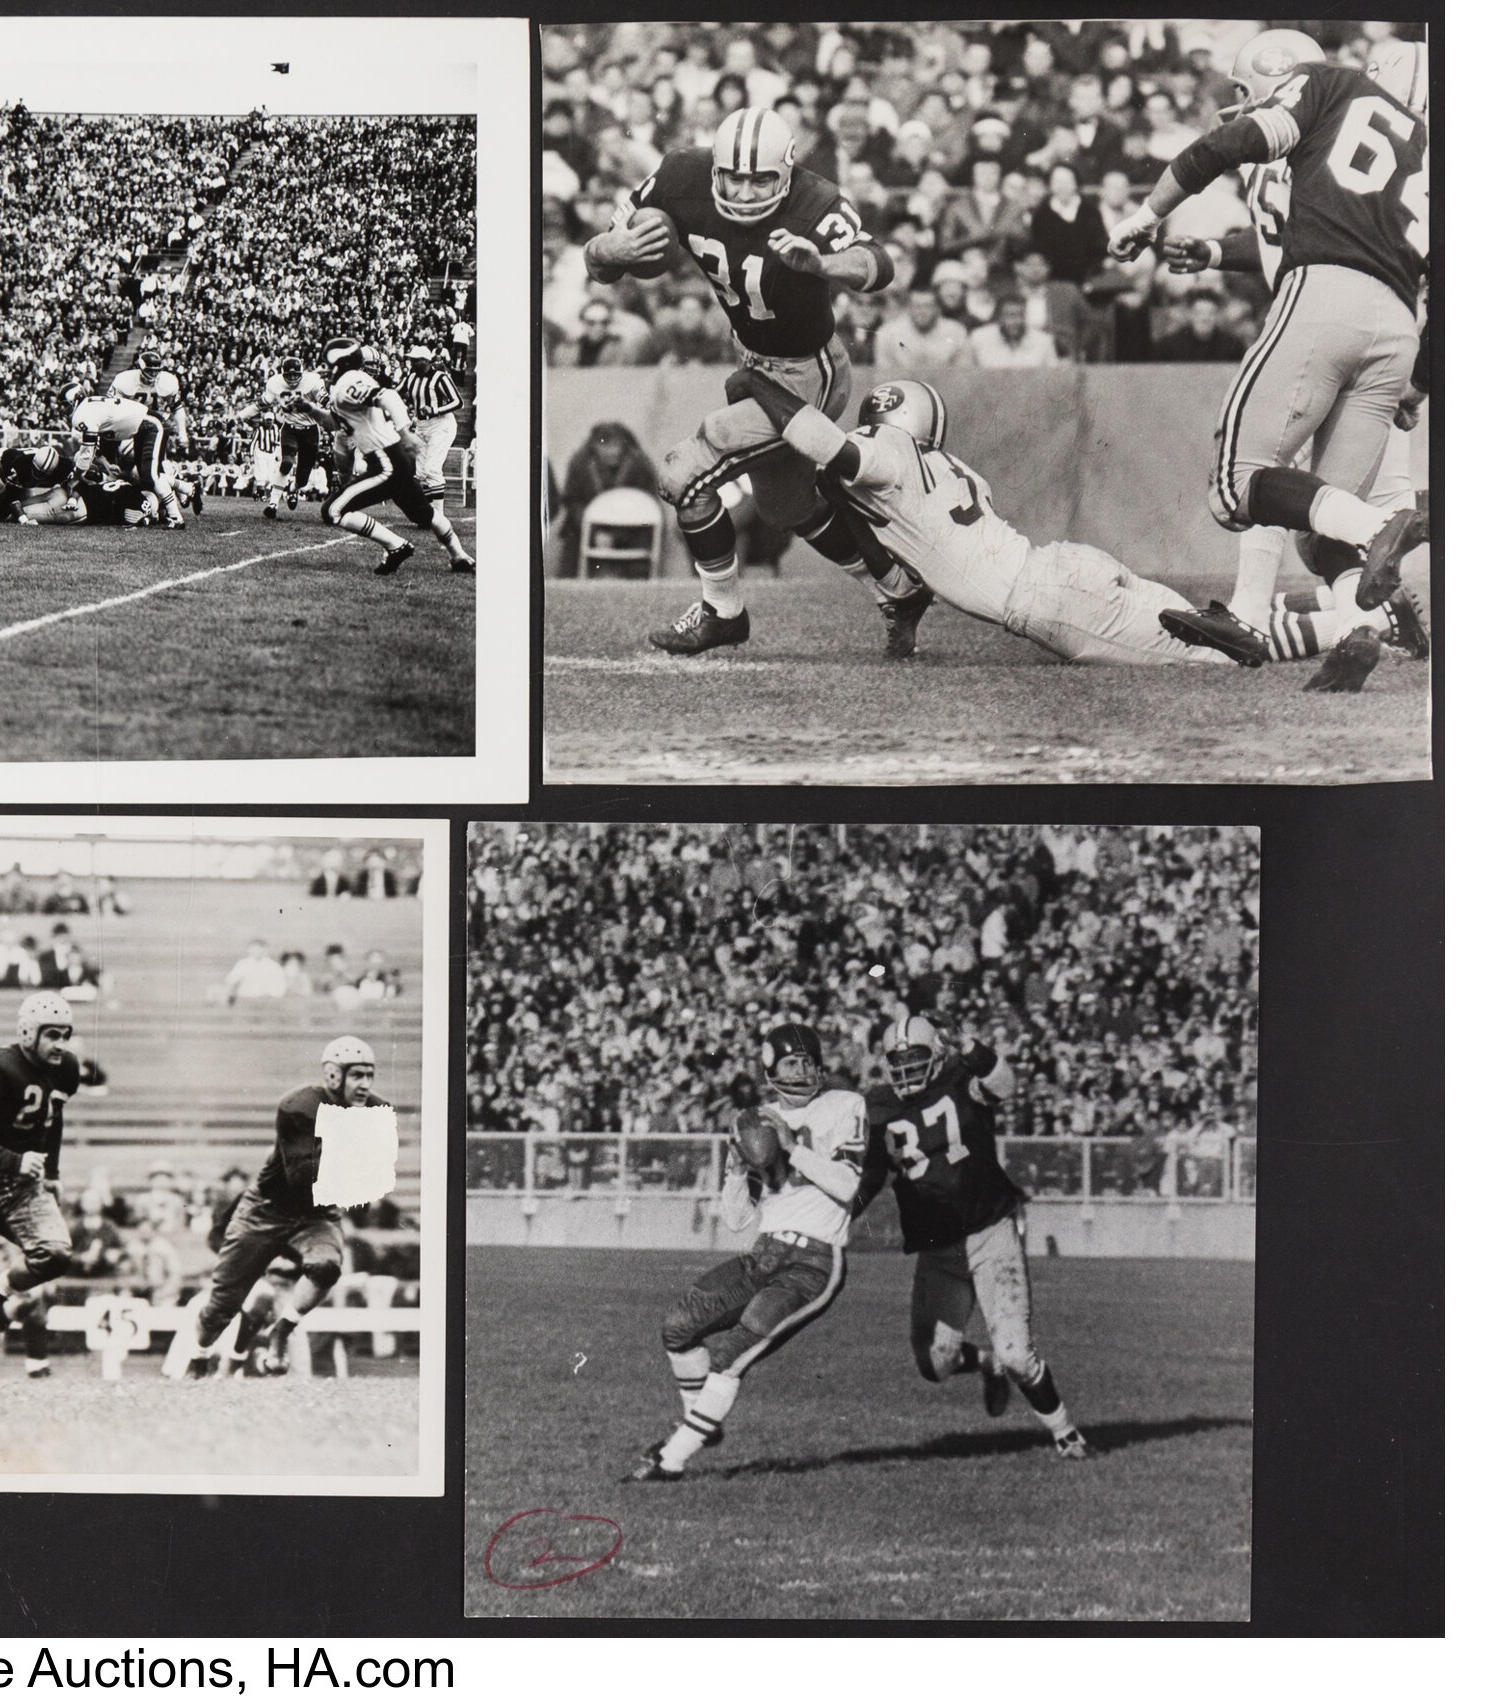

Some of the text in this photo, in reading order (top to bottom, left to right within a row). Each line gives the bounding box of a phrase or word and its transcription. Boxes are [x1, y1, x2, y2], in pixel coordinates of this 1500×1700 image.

[688, 233, 776, 321] 31
[872, 387, 897, 412] SF
[98, 1309, 138, 1337] 45
